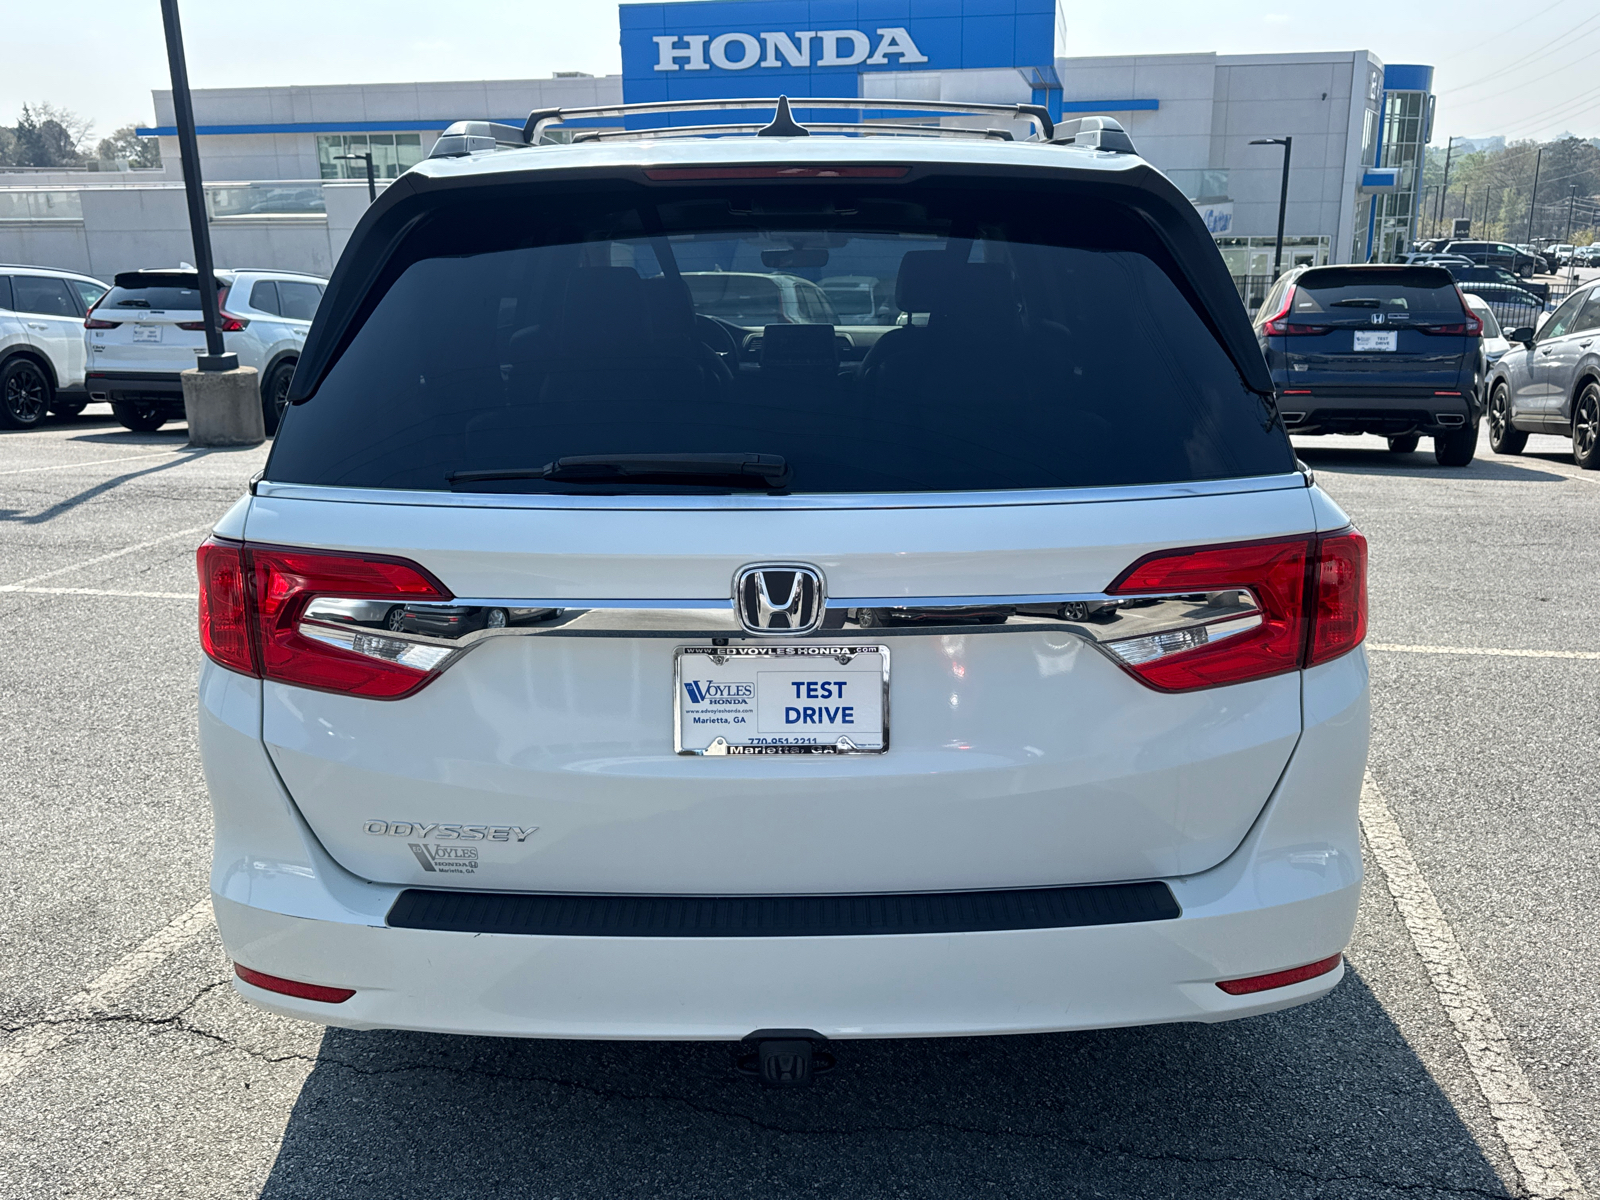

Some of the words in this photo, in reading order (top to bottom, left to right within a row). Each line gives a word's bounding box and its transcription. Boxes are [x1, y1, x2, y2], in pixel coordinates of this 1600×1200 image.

[652, 27, 929, 71] HONDA
[692, 680, 752, 701] VOYLES
[791, 681, 847, 699] TEST
[693, 716, 730, 724] Marietta,
[733, 716, 746, 724] GA
[785, 706, 854, 724] DRIVE
[729, 746, 804, 754] Marietta,
[811, 746, 834, 754] GA
[362, 819, 540, 842] ODYSSEY
[422, 843, 477, 860] VOYLES
